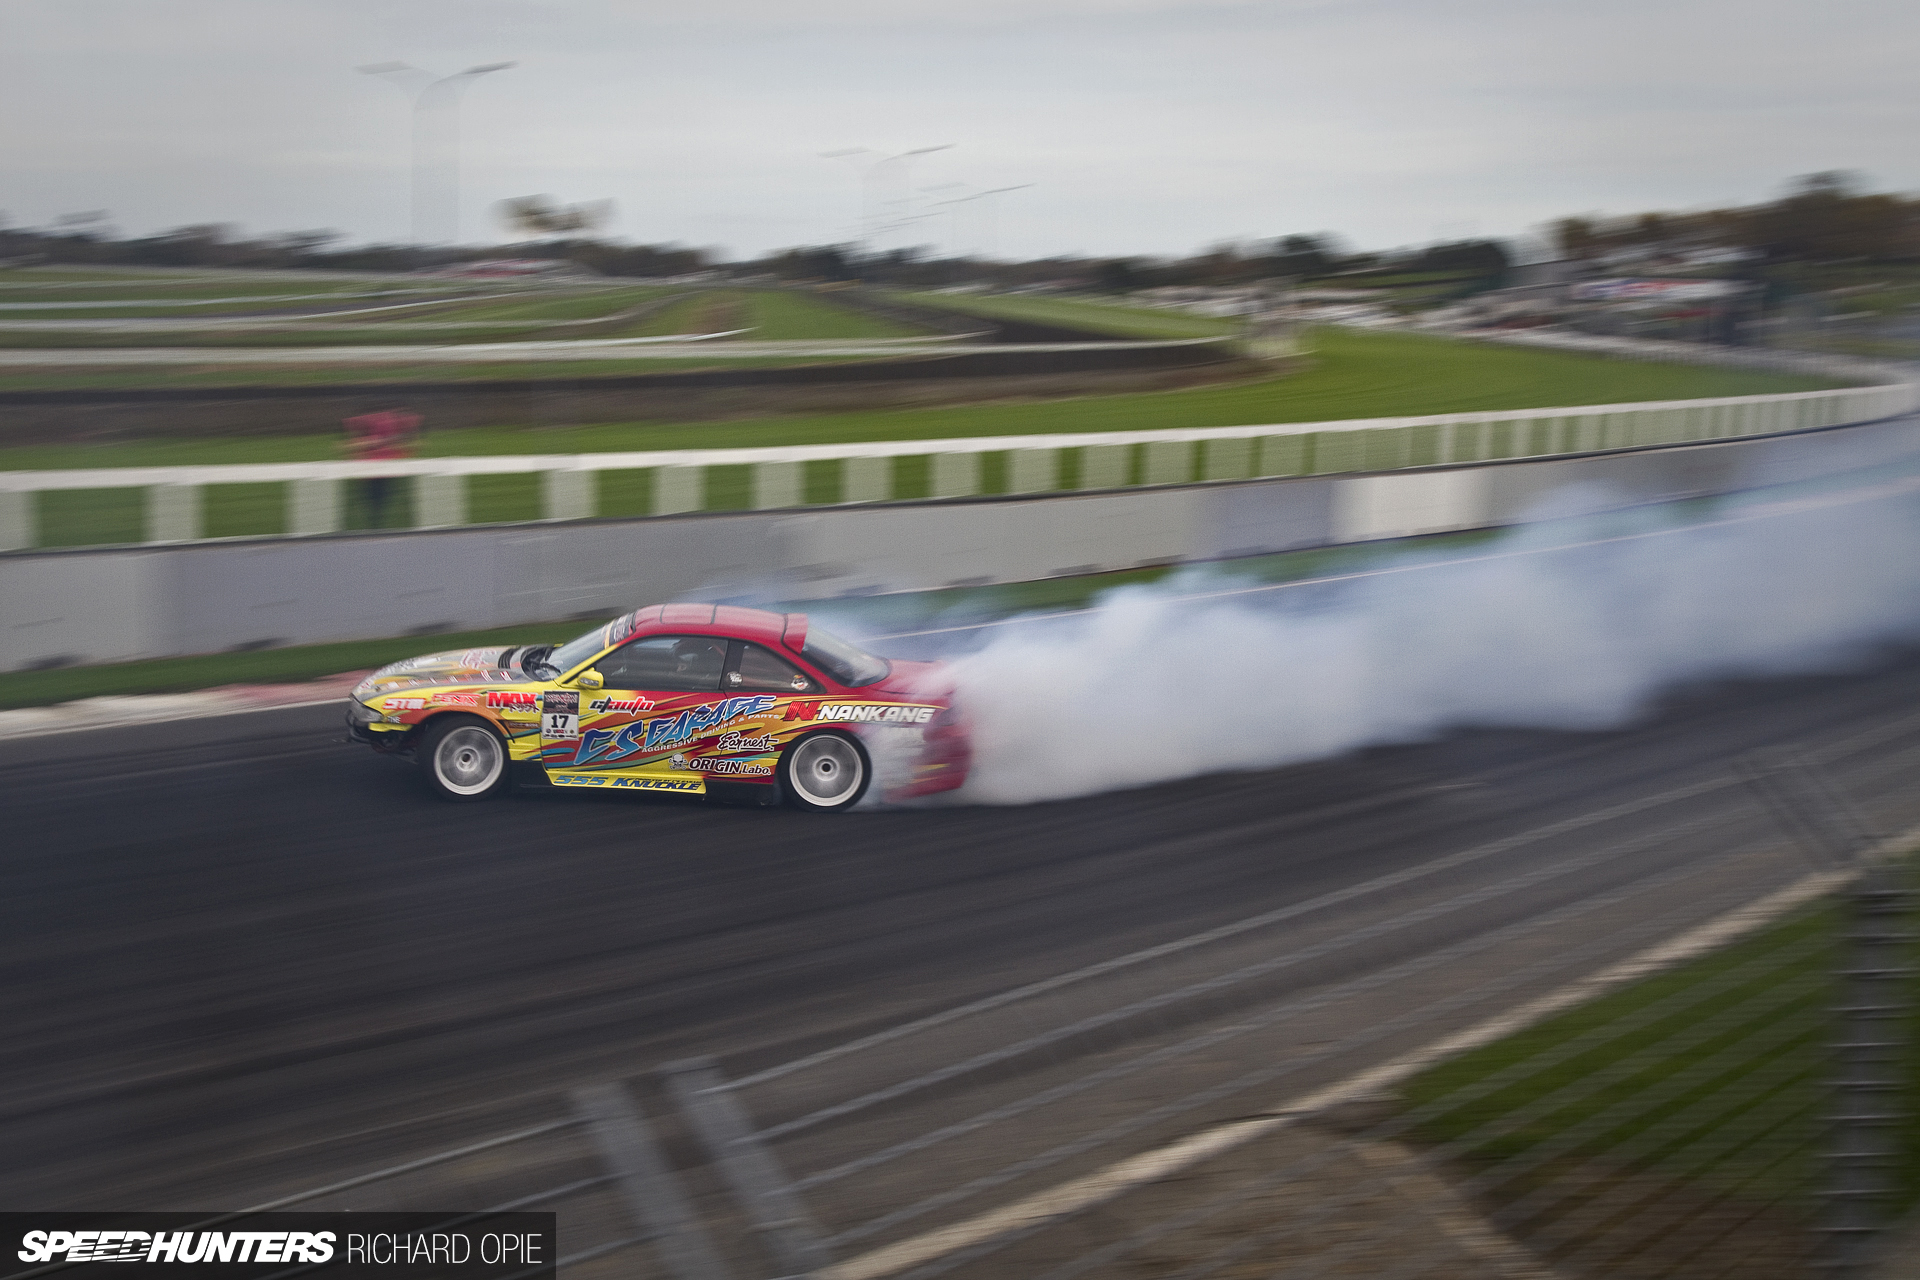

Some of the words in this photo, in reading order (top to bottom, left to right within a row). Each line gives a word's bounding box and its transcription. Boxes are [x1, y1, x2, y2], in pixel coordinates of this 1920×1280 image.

[486, 691, 538, 709] MAX
[551, 714, 569, 728] 17
[644, 695, 776, 748] GARAGE
[817, 705, 936, 723] NANKANG
[641, 737, 698, 753] AGGRESSIVE
[700, 720, 736, 739] DRIVING
[689, 758, 742, 773] ORIGIN
[553, 775, 609, 786] 555
[611, 777, 702, 791] KNUCKLE
